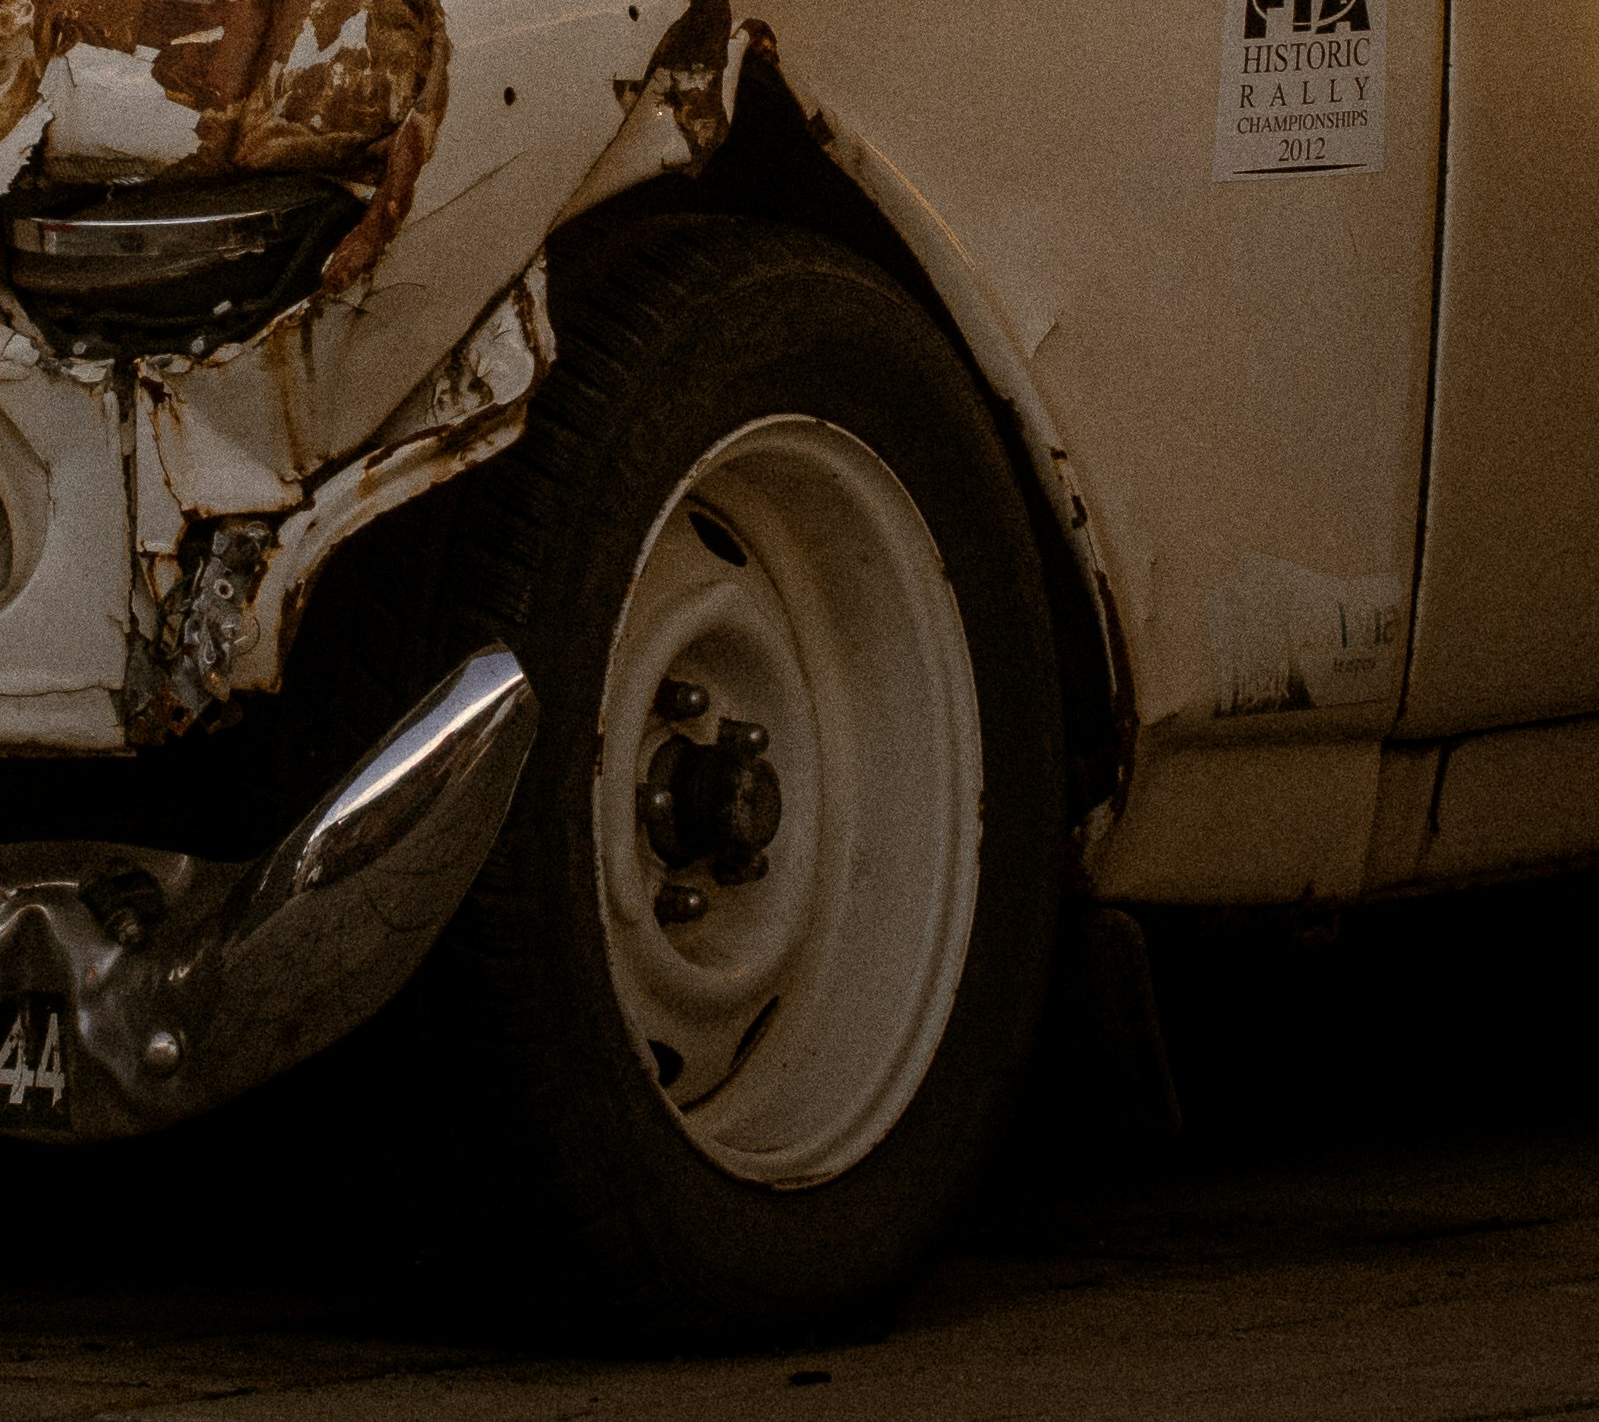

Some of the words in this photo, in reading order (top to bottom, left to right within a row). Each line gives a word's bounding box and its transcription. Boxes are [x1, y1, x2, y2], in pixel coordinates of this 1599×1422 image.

[1241, 37, 1371, 74] HISTORIC
[1239, 76, 1370, 108] RALLY
[1236, 109, 1368, 134] CHAMPIONSHIPS
[1278, 137, 1326, 162] 2012
